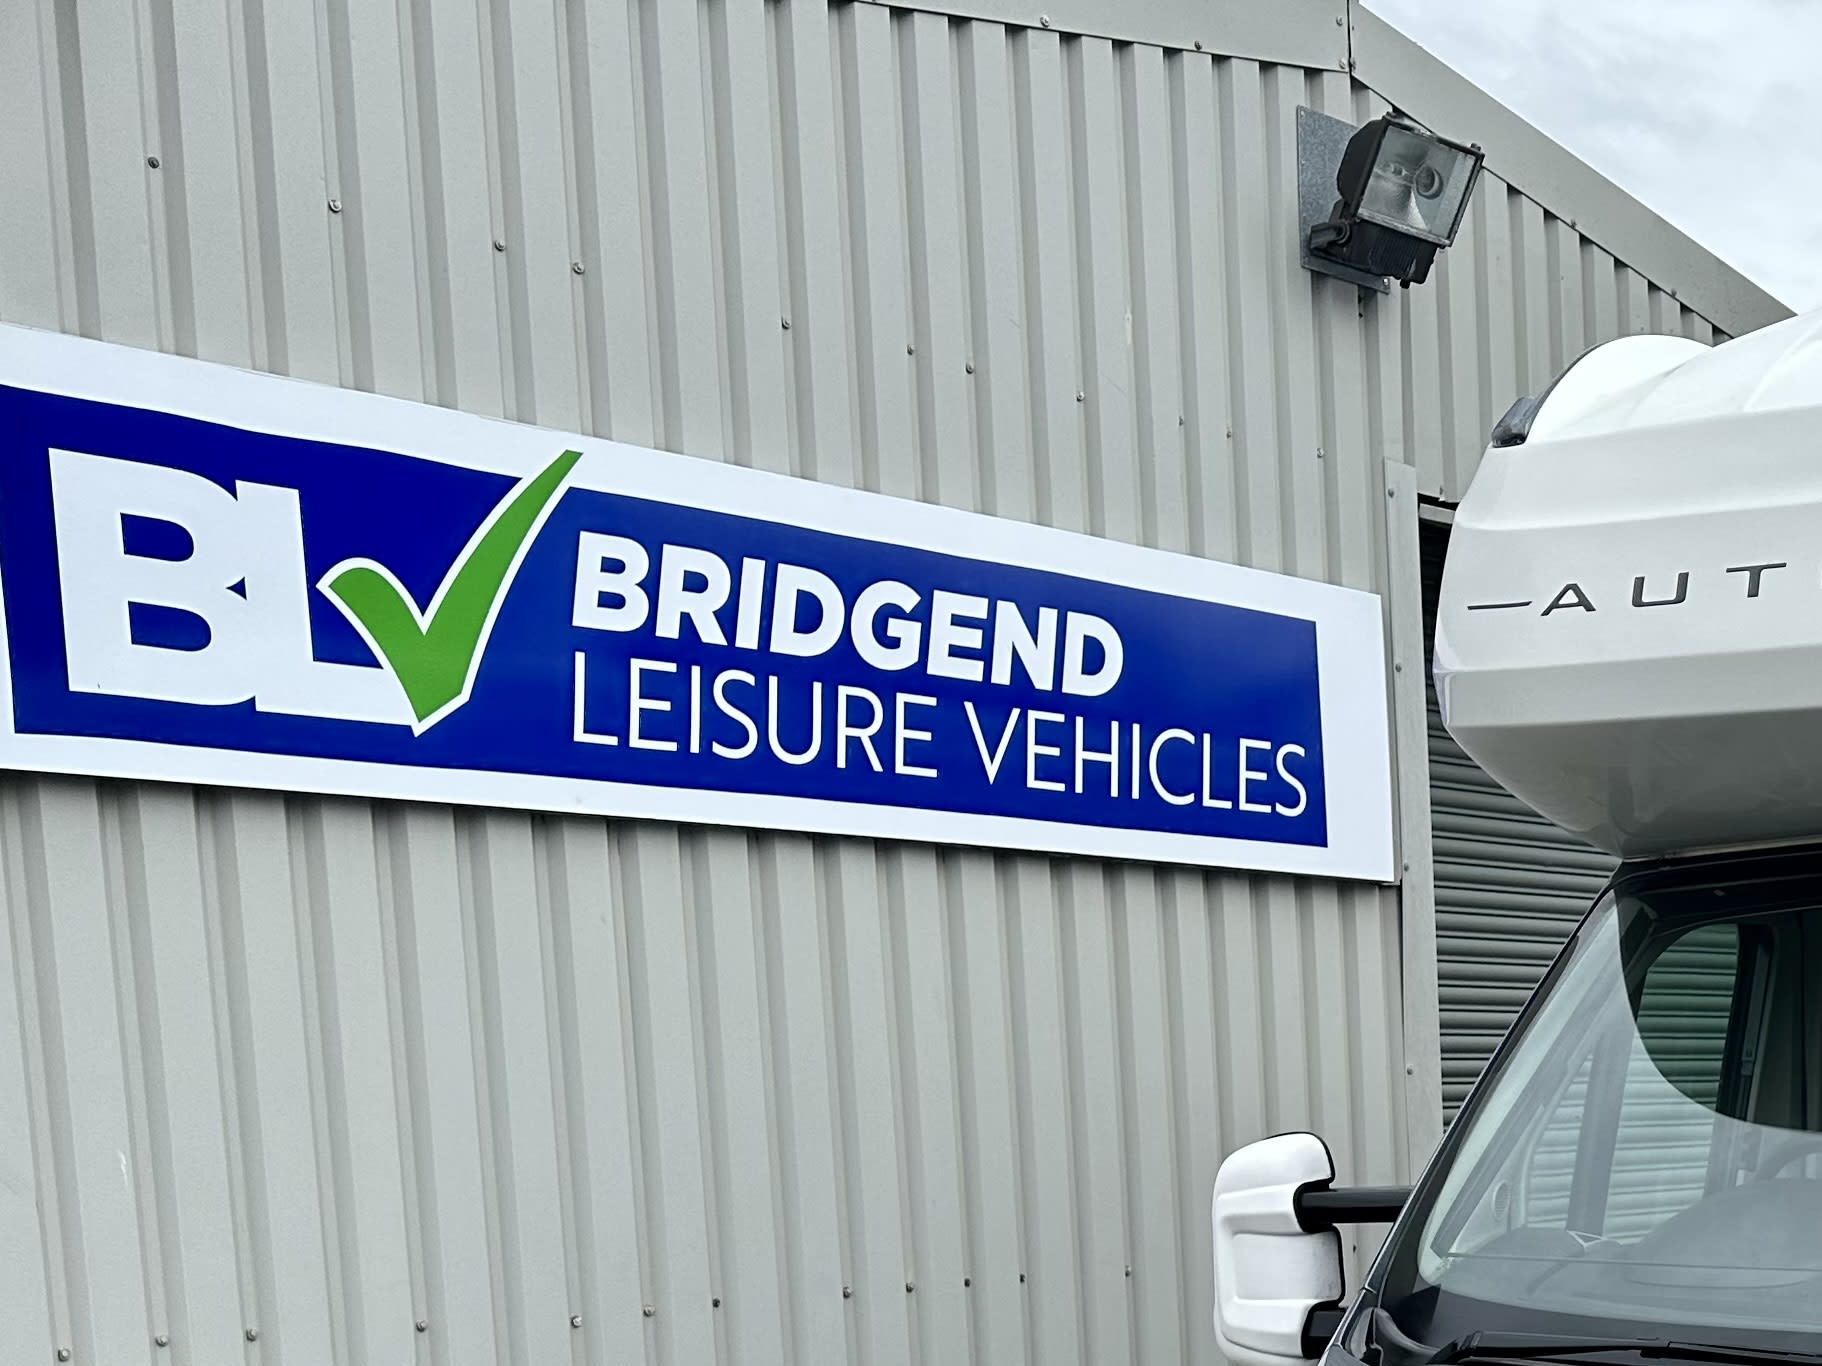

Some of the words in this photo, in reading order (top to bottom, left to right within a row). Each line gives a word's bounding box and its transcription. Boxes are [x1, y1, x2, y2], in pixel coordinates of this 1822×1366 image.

[572, 531, 1123, 697] BRIDGEND
[574, 651, 938, 778] LEISURE
[964, 701, 1307, 817] VEHICLES
